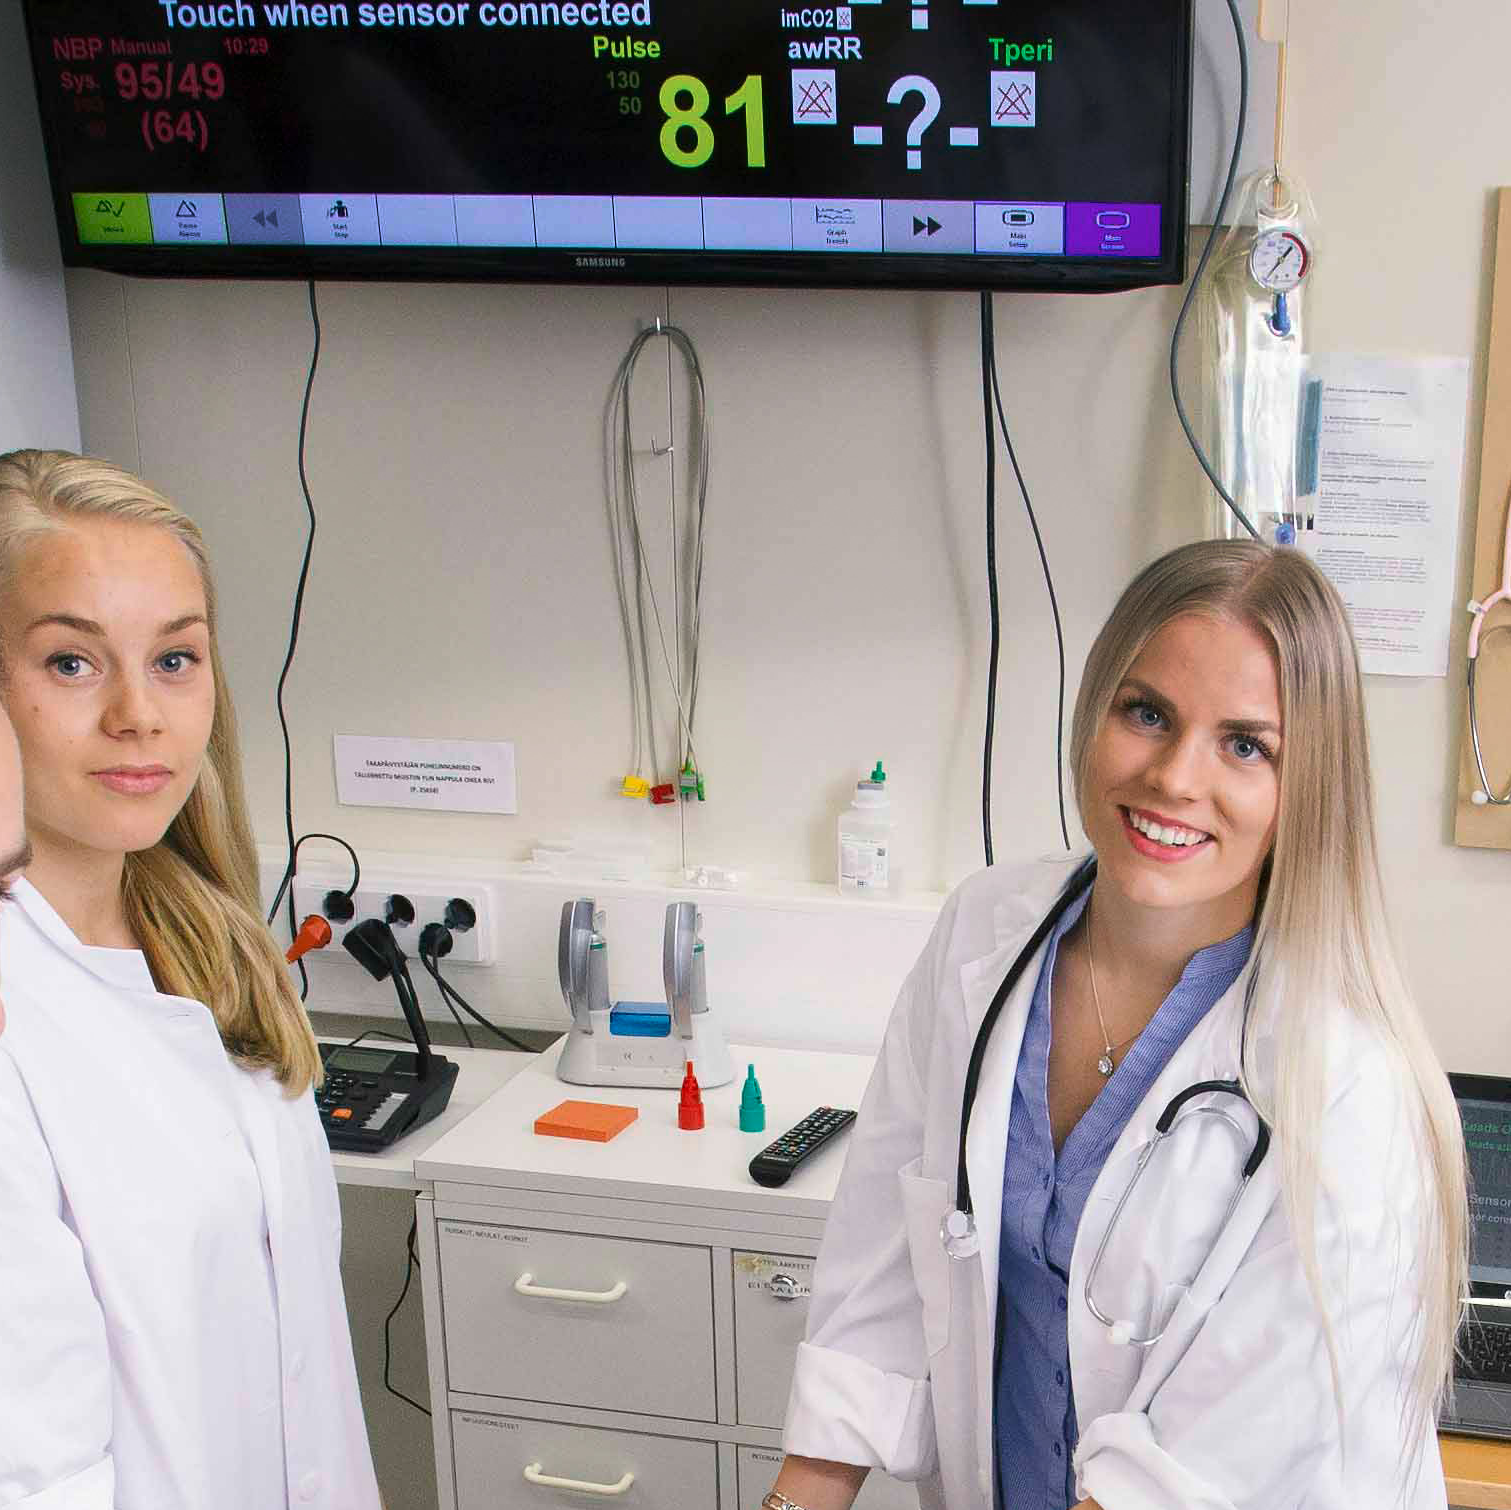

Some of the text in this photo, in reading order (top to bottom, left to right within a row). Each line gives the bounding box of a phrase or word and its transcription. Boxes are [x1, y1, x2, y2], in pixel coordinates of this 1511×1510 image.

[159, 0, 652, 28] Touch when sensor connected
[780, 7, 834, 30] imCO2
[52, 38, 104, 60] NBP
[110, 38, 172, 56] Manual
[593, 35, 662, 60] Pulse
[787, 37, 863, 61] awRR
[989, 36, 1054, 66] Tperi
[113, 61, 226, 101] 95/49
[606, 70, 641, 90] 130
[619, 96, 642, 115] 50
[141, 109, 210, 152] (64)
[658, 73, 766, 168] 81
[575, 257, 627, 267] SAMSUNG
